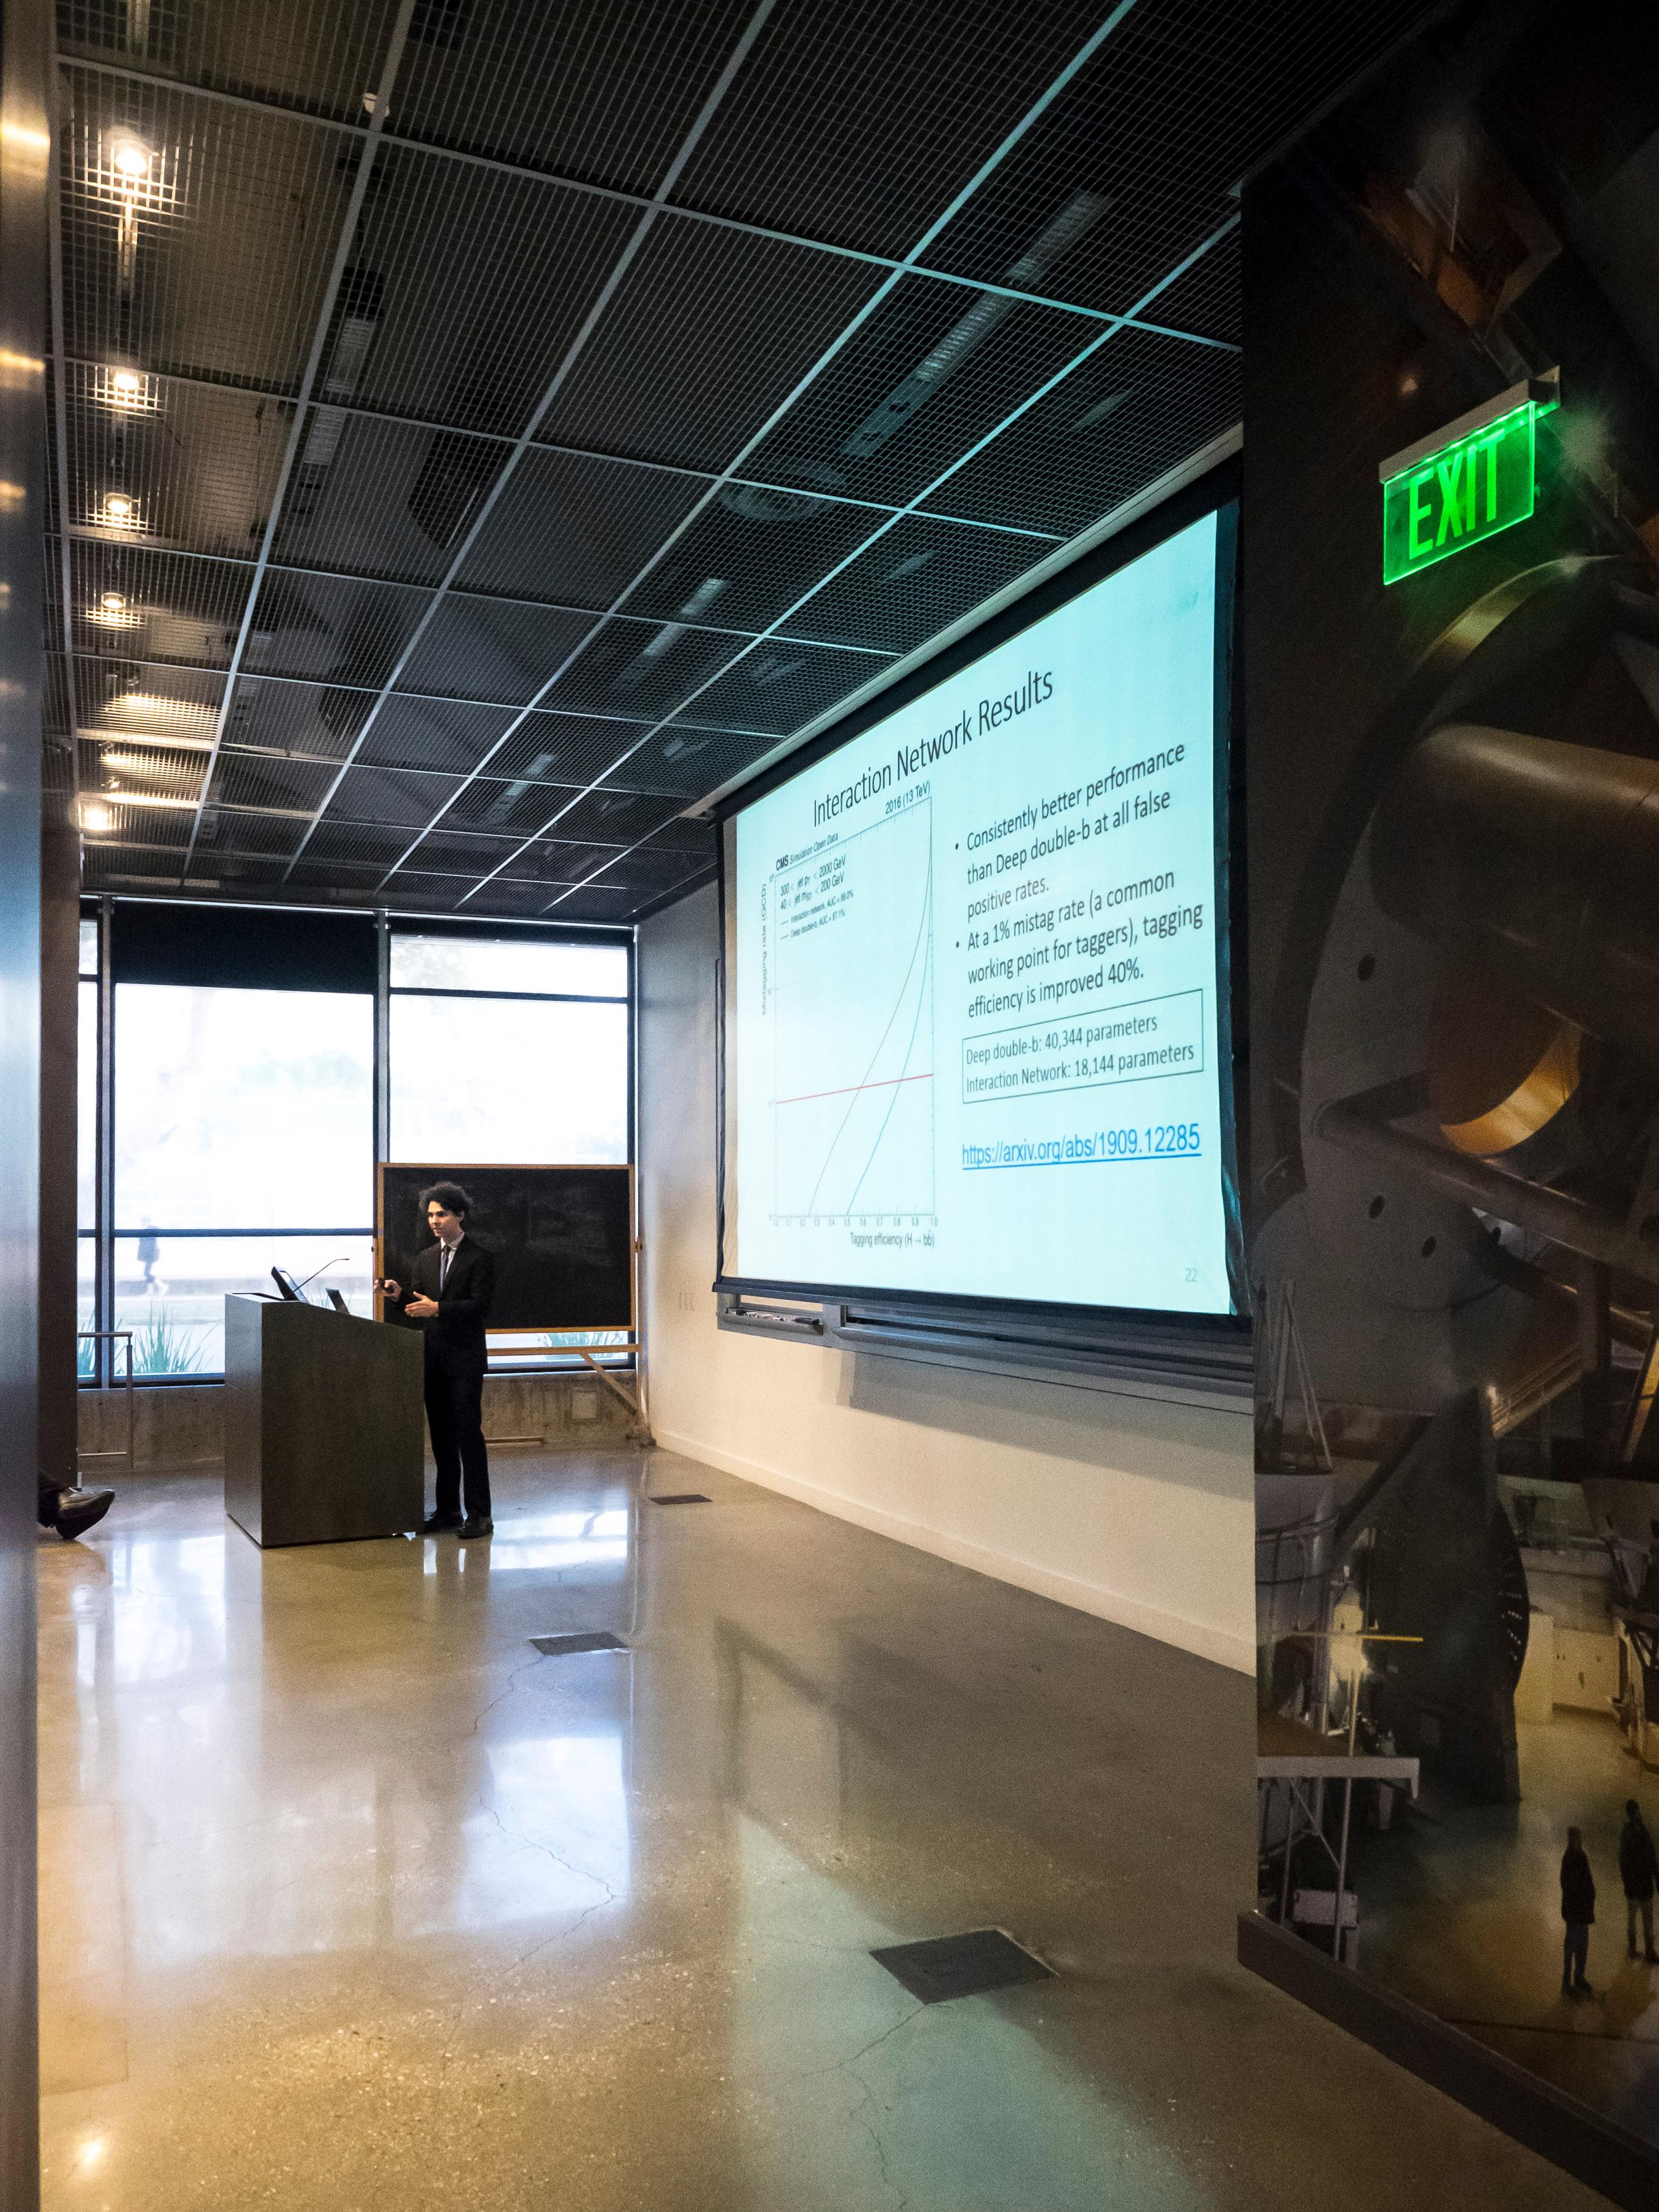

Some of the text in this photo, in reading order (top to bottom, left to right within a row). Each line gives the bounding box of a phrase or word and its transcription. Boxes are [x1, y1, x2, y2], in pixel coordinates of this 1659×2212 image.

[1409, 428, 1505, 560] EXIT
[814, 671, 1053, 827] Interaction Network Results
[886, 779, 930, 814] 2016 (13 TeV)
[967, 743, 1184, 850] Consistently better performance
[967, 790, 1171, 884] than Deep double-b at all false
[776, 854, 789, 871] CMS
[819, 862, 832, 877] 2000
[833, 855, 846, 871] GeV
[820, 878, 831, 892] 200
[832, 871, 844, 887] GeV
[967, 877, 1049, 923] positive rates.
[967, 871, 1174, 951] At a 1% mistag rate (a common
[968, 904, 1203, 984] working point for taggers), tagging
[968, 957, 1144, 1018] efficiency is improved 40%.
[967, 1016, 1157, 1064] Deep double-b: 40,344 parameters
[967, 1044, 1194, 1092] Interaction Network: 18,144 parameters
[962, 1123, 1200, 1167] https://arxiv.org/abs/1909.12285
[850, 1232, 873, 1248] Tagging
[874, 1232, 902, 1248] efficiency
[1185, 1268, 1197, 1282] 22
